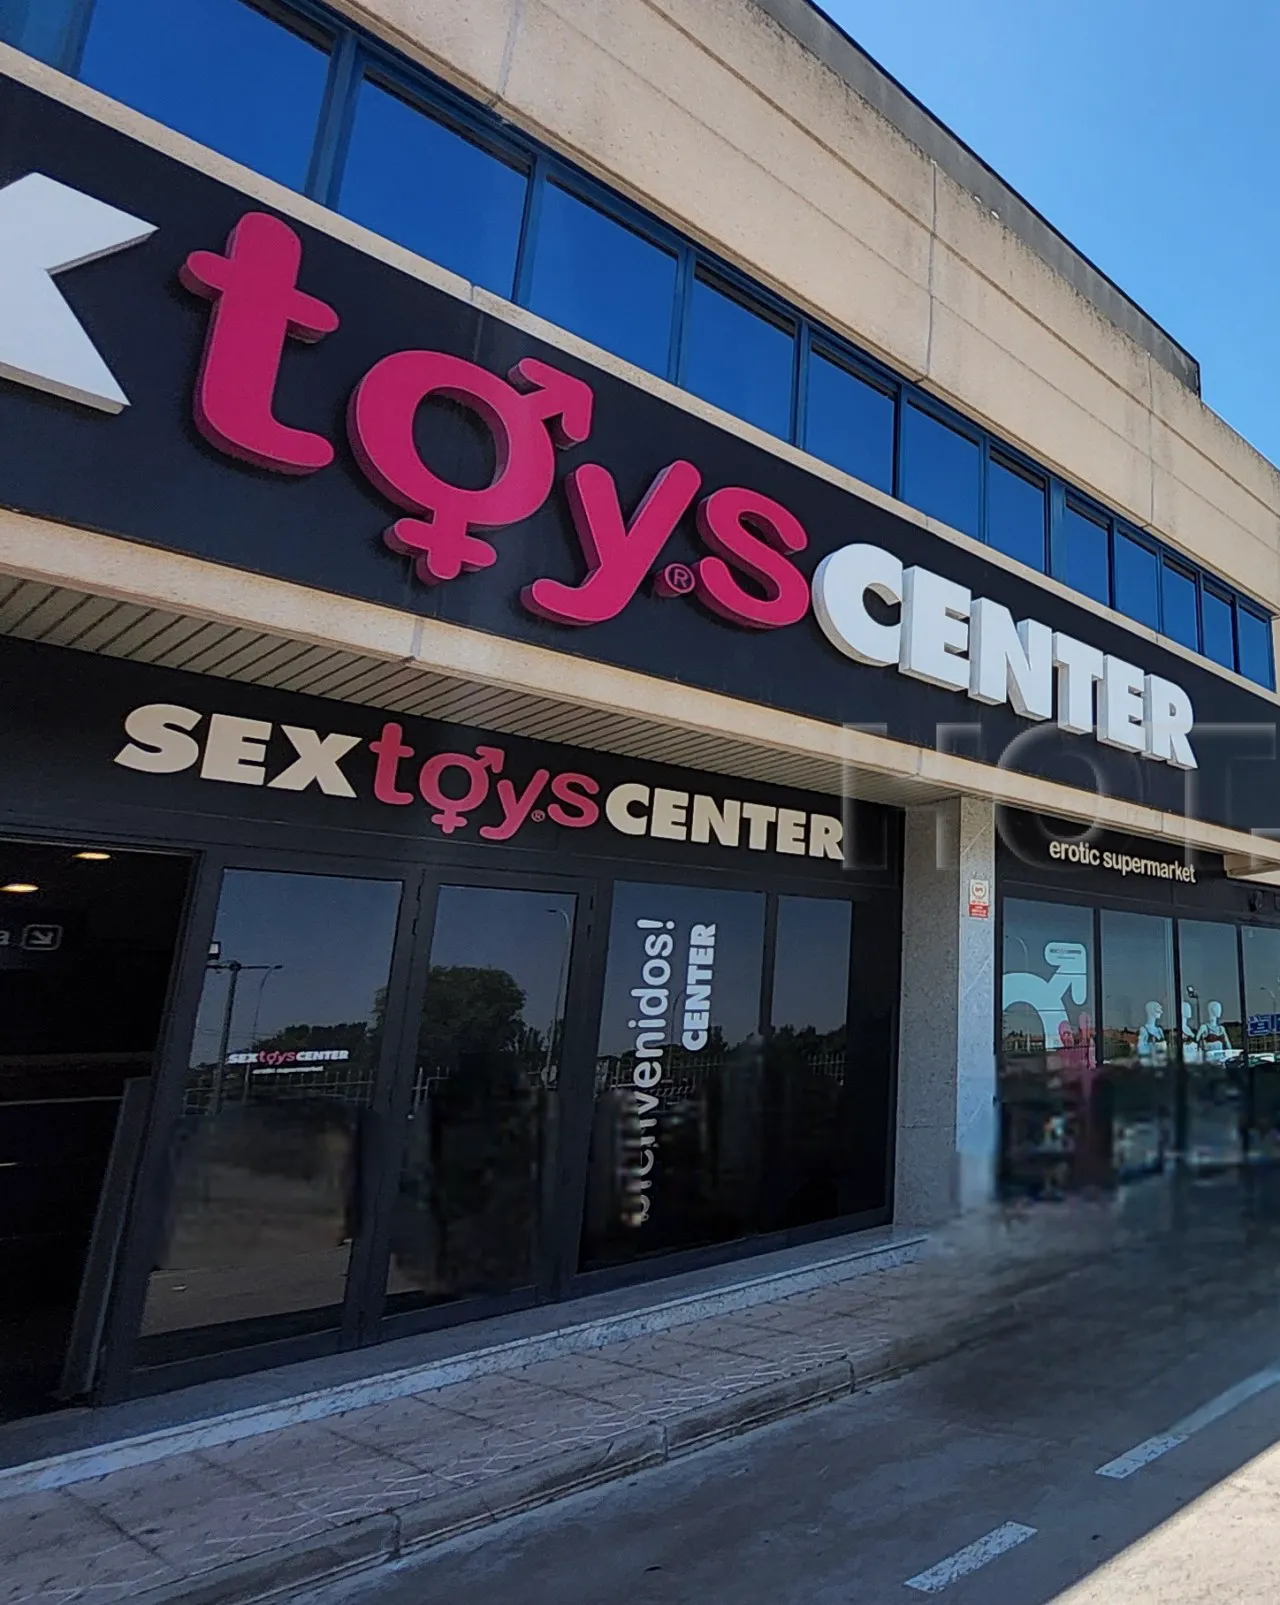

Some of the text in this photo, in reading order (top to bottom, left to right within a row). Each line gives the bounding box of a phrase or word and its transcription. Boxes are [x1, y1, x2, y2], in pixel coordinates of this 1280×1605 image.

[811, 543, 1198, 769] CENTER
[1050, 841, 1197, 883] erotic supermarket
[682, 923, 717, 1051] CENTER
